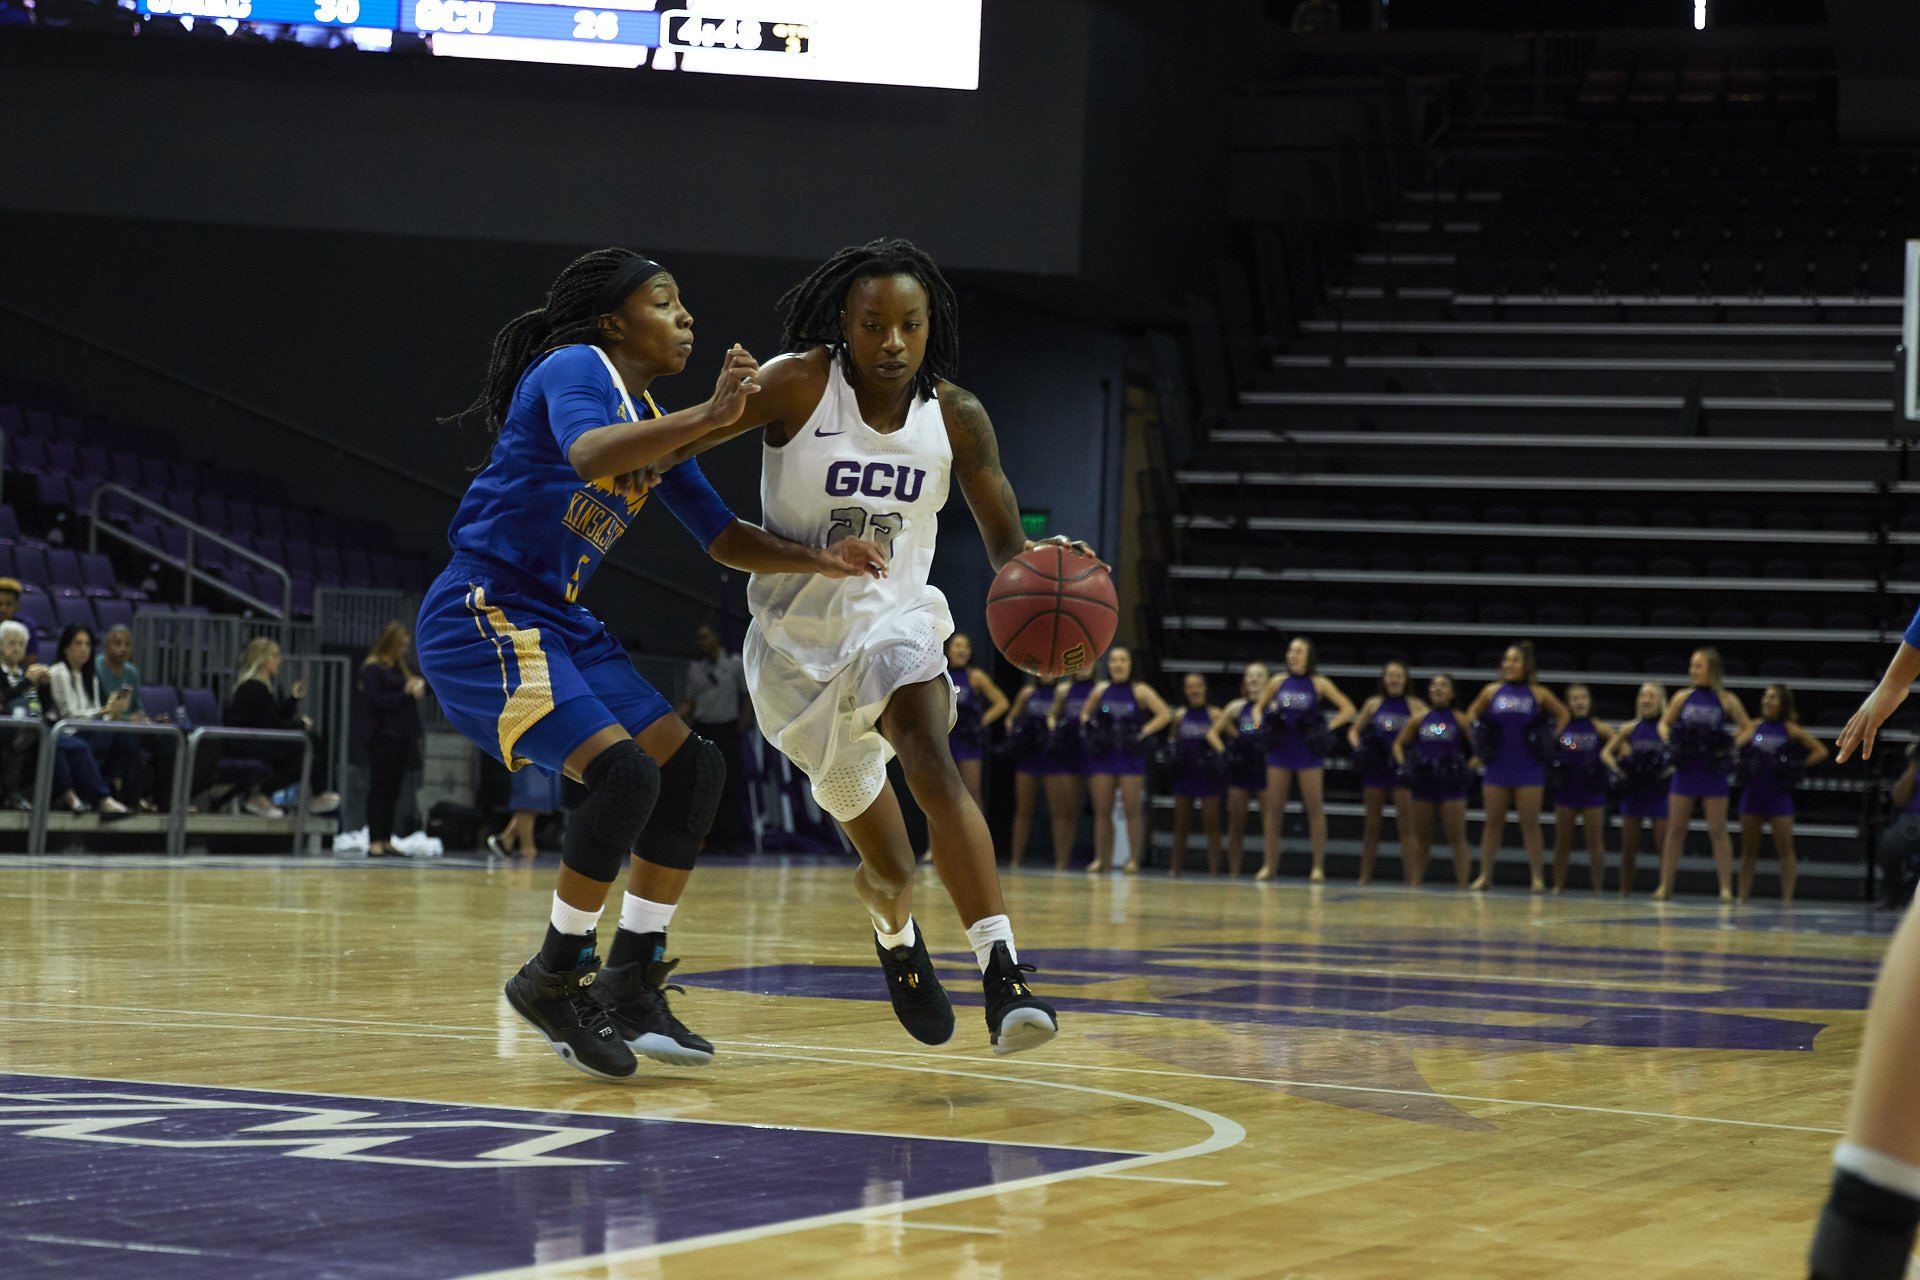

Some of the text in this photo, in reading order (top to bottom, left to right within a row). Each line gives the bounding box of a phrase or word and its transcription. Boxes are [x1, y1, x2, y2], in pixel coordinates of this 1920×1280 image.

[314, 0, 360, 24] 30
[415, 0, 496, 34] GCU
[825, 460, 926, 503] GCU
